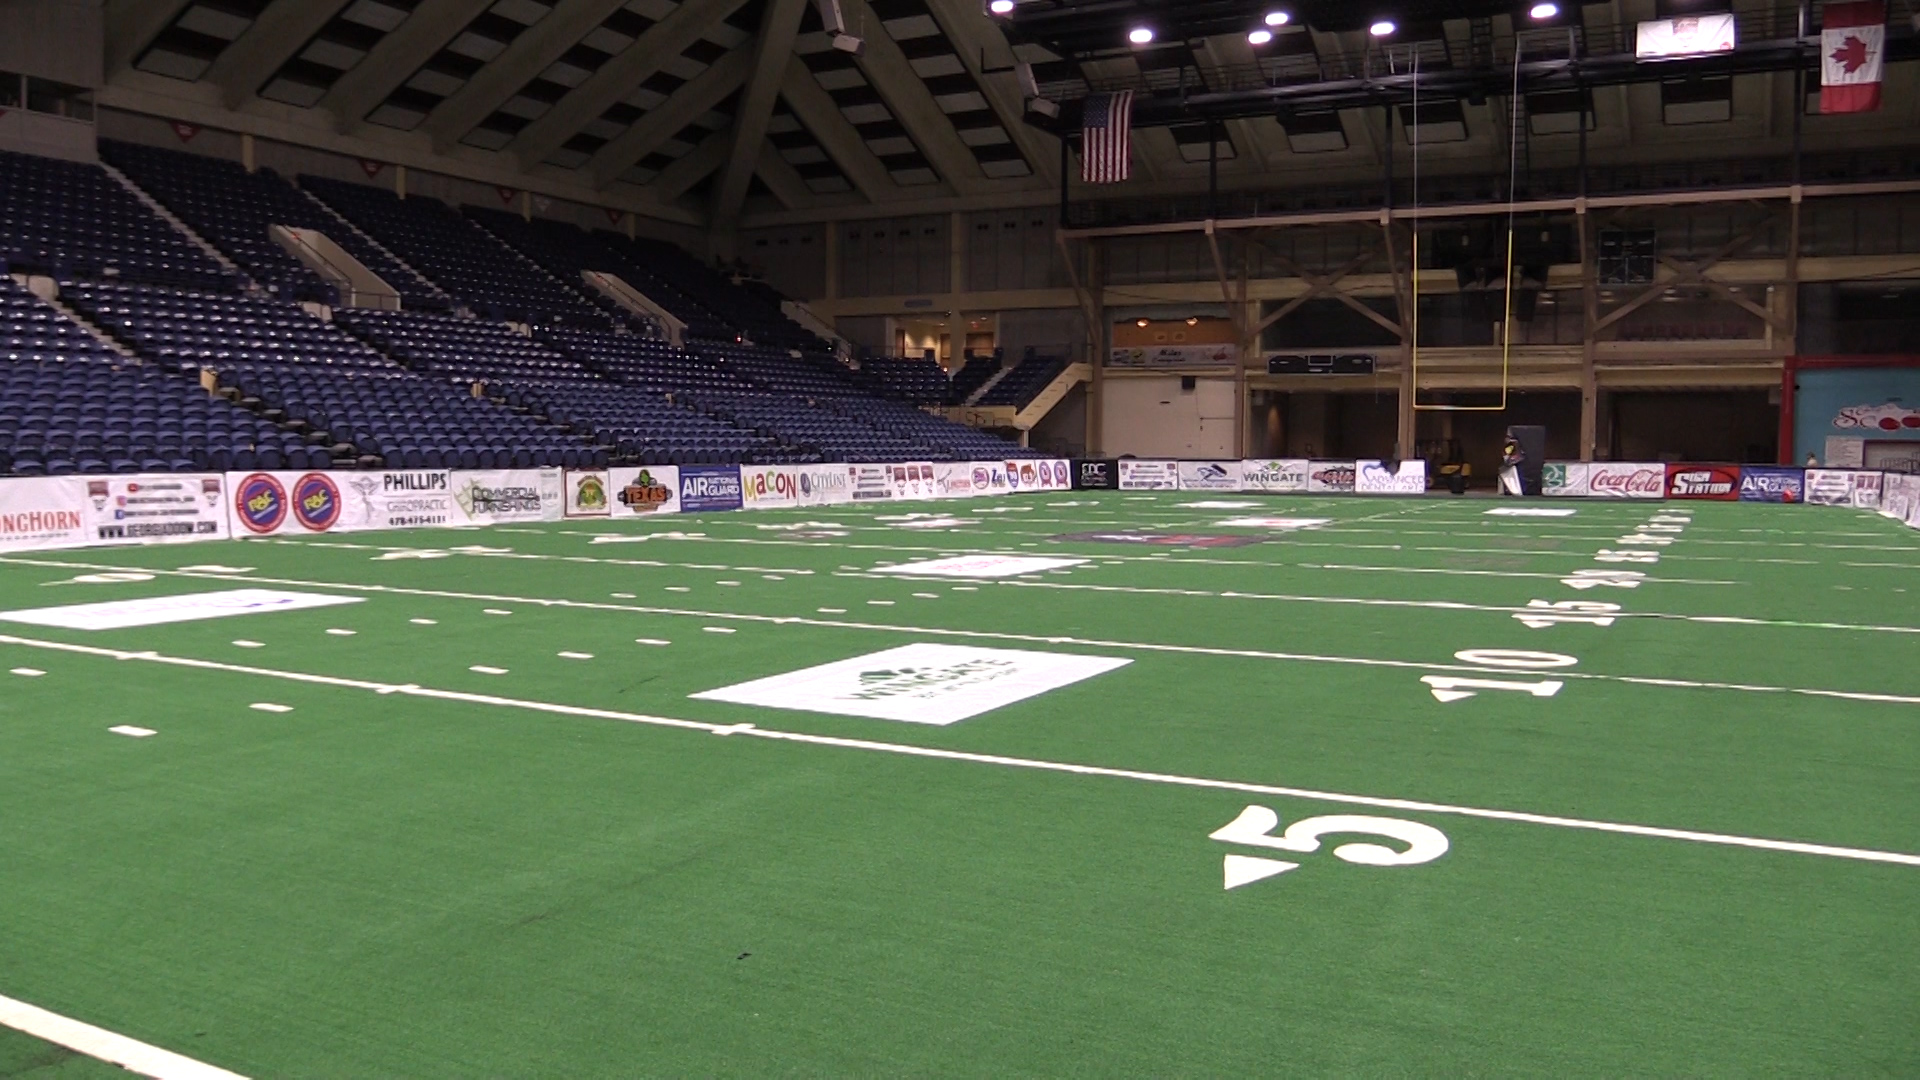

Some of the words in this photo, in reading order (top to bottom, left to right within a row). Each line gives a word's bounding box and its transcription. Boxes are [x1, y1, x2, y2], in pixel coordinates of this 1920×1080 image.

[383, 473, 447, 491] PHILLIPS
[682, 476, 709, 498] AIR
[1243, 473, 1304, 482] WINGATE
[1591, 469, 1664, 492] Coca-Cola
[708, 485, 739, 495] GUARD
[1420, 649, 1579, 697] 10
[1207, 804, 1449, 866] 5
